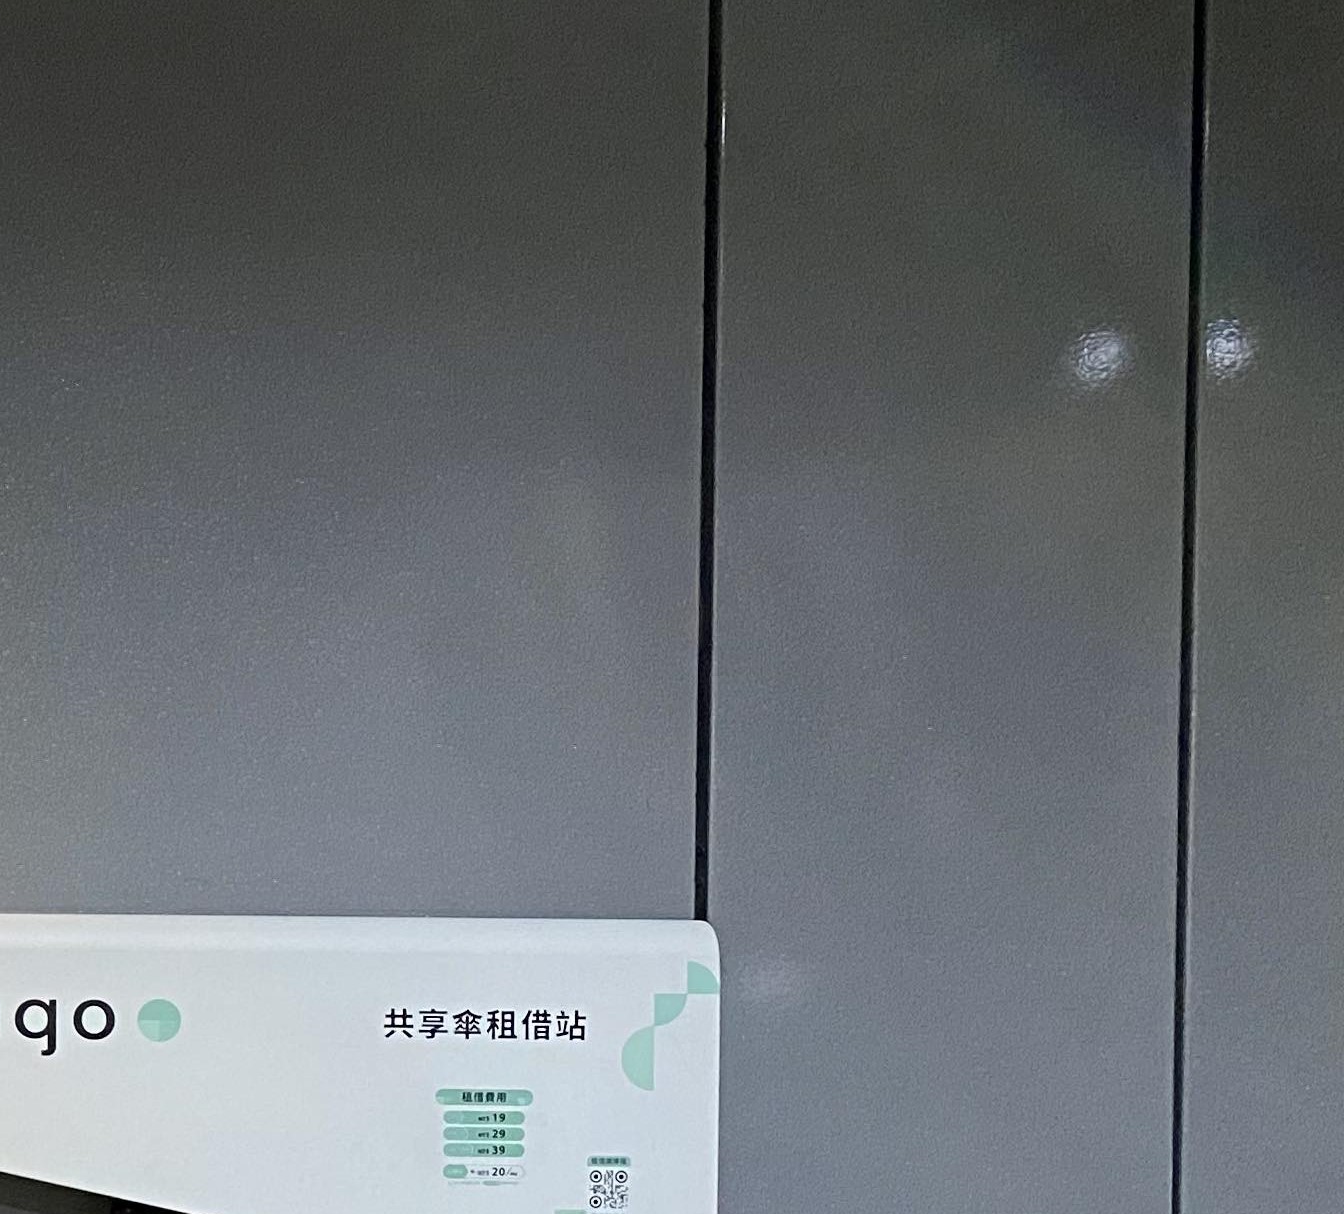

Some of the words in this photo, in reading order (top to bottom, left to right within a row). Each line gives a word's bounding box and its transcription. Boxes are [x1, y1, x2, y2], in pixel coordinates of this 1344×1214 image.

[383, 1008, 587, 1041] 共享傘租借站
[493, 1113, 506, 1122] 19
[492, 1129, 506, 1139] 29
[492, 1145, 506, 1155] 39
